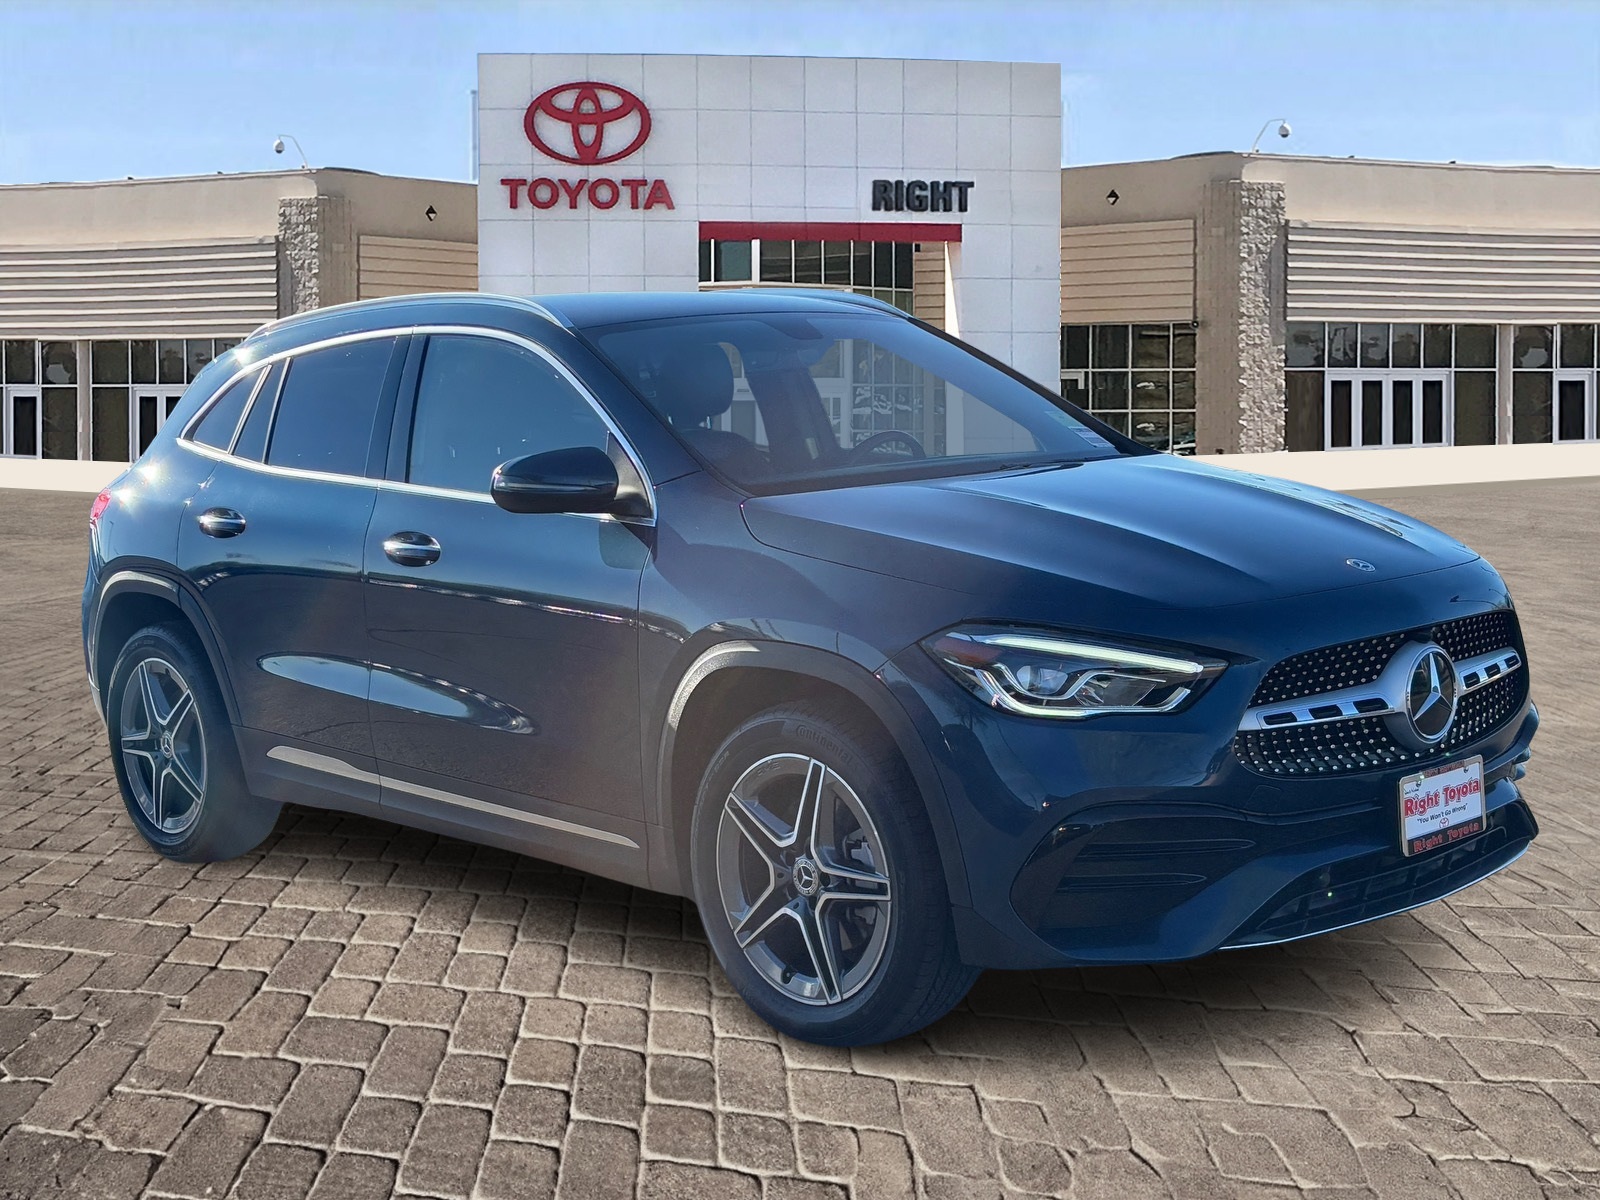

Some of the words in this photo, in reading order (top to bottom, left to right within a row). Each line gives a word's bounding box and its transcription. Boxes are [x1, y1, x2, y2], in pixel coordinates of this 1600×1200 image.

[500, 178, 675, 210] TOYOTA
[871, 179, 975, 213] RIGHT
[1404, 790, 1440, 817] Right
[1442, 778, 1480, 807] Toyota
[1430, 811, 1445, 822] Won't
[1445, 809, 1452, 817] Go
[1413, 834, 1443, 853] Right
[1447, 822, 1480, 839] Toyota
